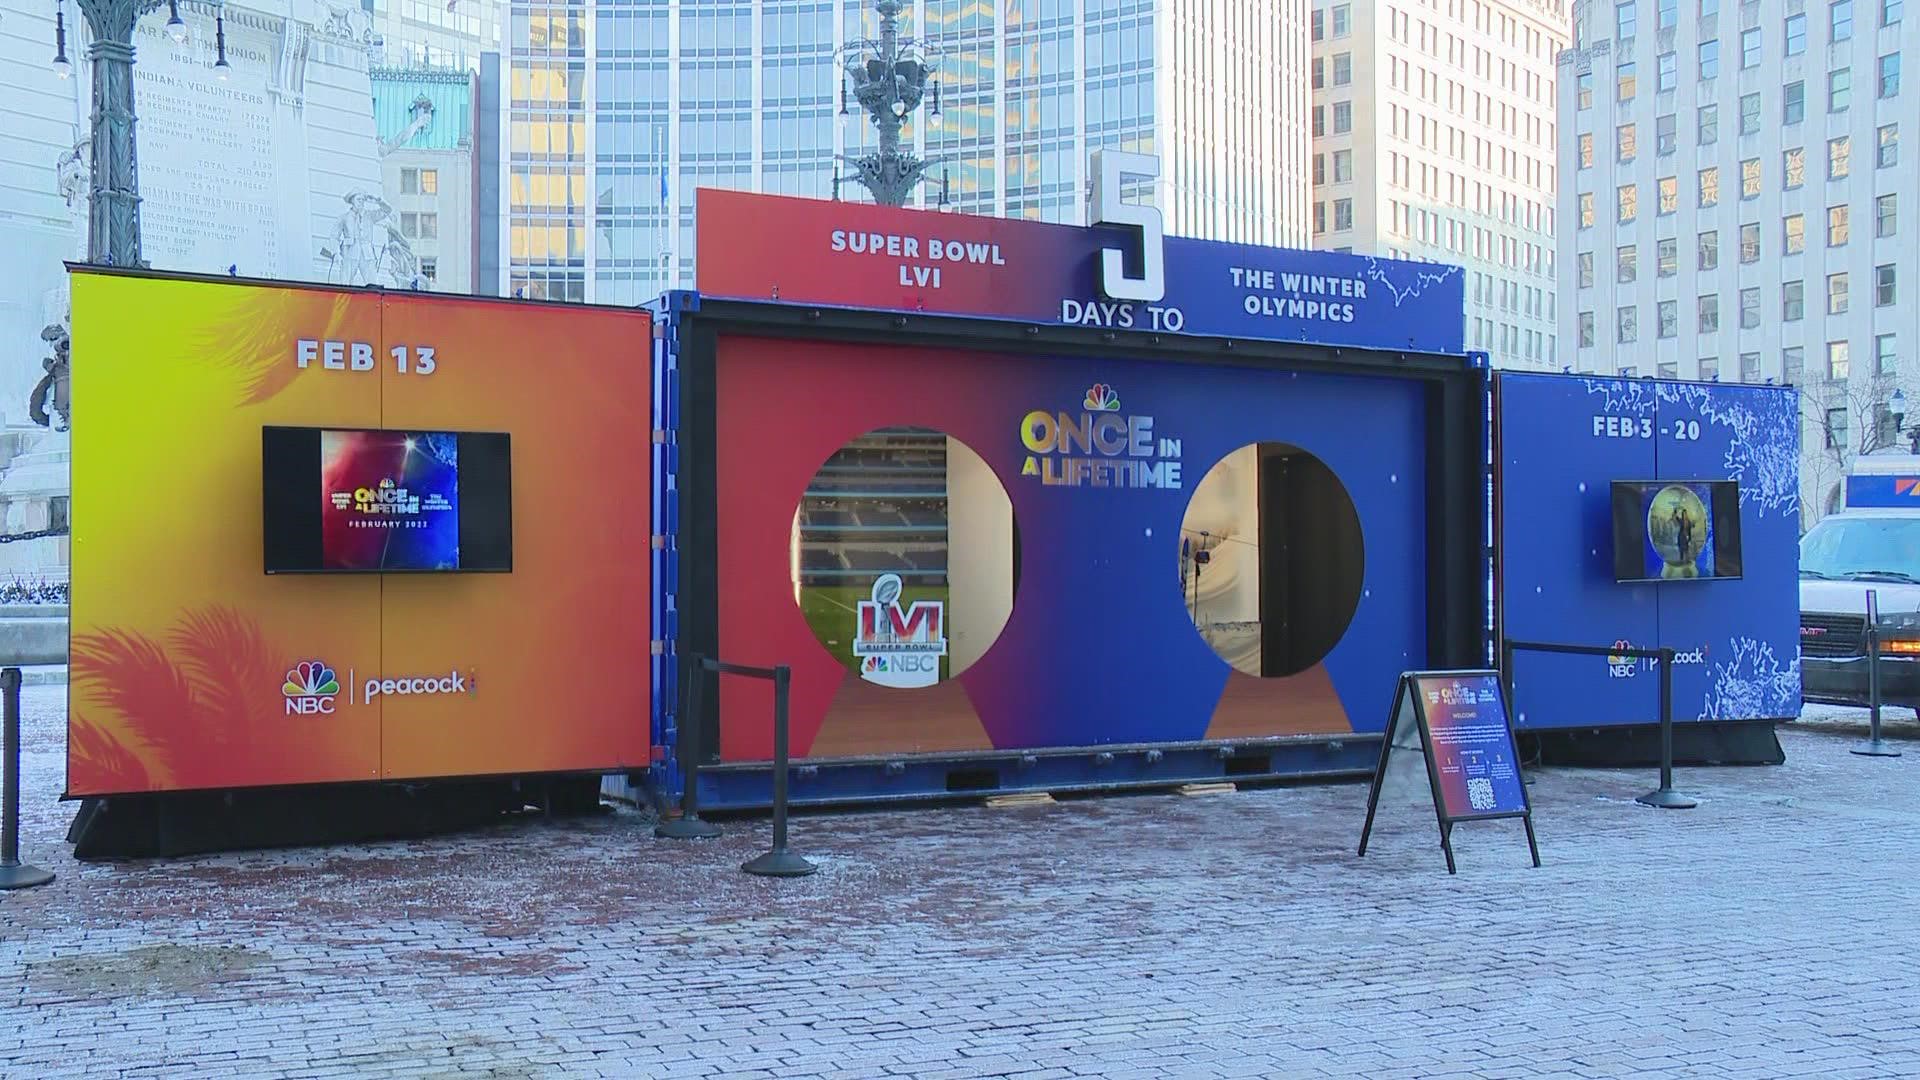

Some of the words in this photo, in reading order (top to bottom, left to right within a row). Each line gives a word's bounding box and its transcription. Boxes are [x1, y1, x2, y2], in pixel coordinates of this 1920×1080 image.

[162, 30, 190, 45] FR
[226, 45, 266, 62] UNION
[134, 69, 184, 88] INDIANA
[188, 81, 263, 105] VOLUNTEERS
[1097, 149, 1166, 301] 5
[831, 230, 920, 258] SUPER
[928, 239, 1006, 265] BOWL
[899, 265, 941, 289] LVI
[1229, 267, 1275, 290] THE
[1281, 272, 1367, 299] WINTER
[1062, 299, 1134, 328] DAYS
[1147, 306, 1184, 332] TO
[1244, 295, 1354, 323] OLYMPICS
[297, 339, 375, 371] FEB
[390, 345, 437, 375] 13
[1020, 410, 1155, 457] ONCE
[1159, 438, 1182, 458] IN
[1593, 416, 1634, 437] FEB
[1640, 418, 1652, 438] 3
[1675, 420, 1700, 440] 20
[1021, 456, 1040, 476] A
[1041, 457, 1182, 489] LIFETIME
[354, 488, 408, 503] ONCE
[363, 503, 419, 514] LIFETIME
[891, 655, 934, 673] NBC
[1609, 664, 1636, 678] NBC
[1649, 647, 1704, 671] pcock
[286, 697, 336, 715] NBC
[365, 671, 466, 705] peacock
